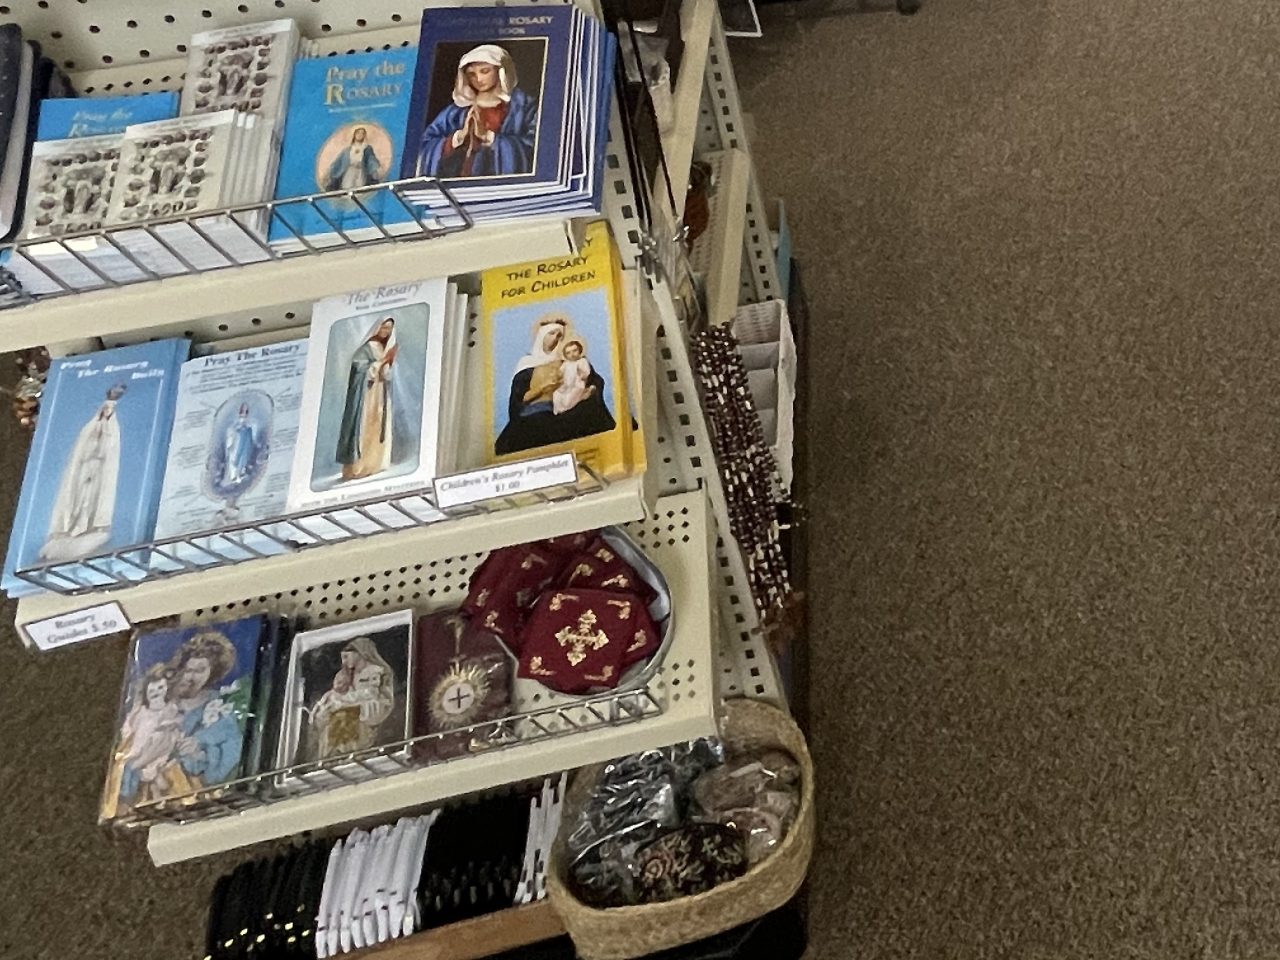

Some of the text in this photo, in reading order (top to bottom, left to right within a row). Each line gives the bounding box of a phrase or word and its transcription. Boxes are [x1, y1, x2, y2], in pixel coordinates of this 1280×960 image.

[506, 268, 532, 281] THE
[501, 286, 526, 299] FOR
[440, 459, 569, 492] Children's Rosary Pamphlet
